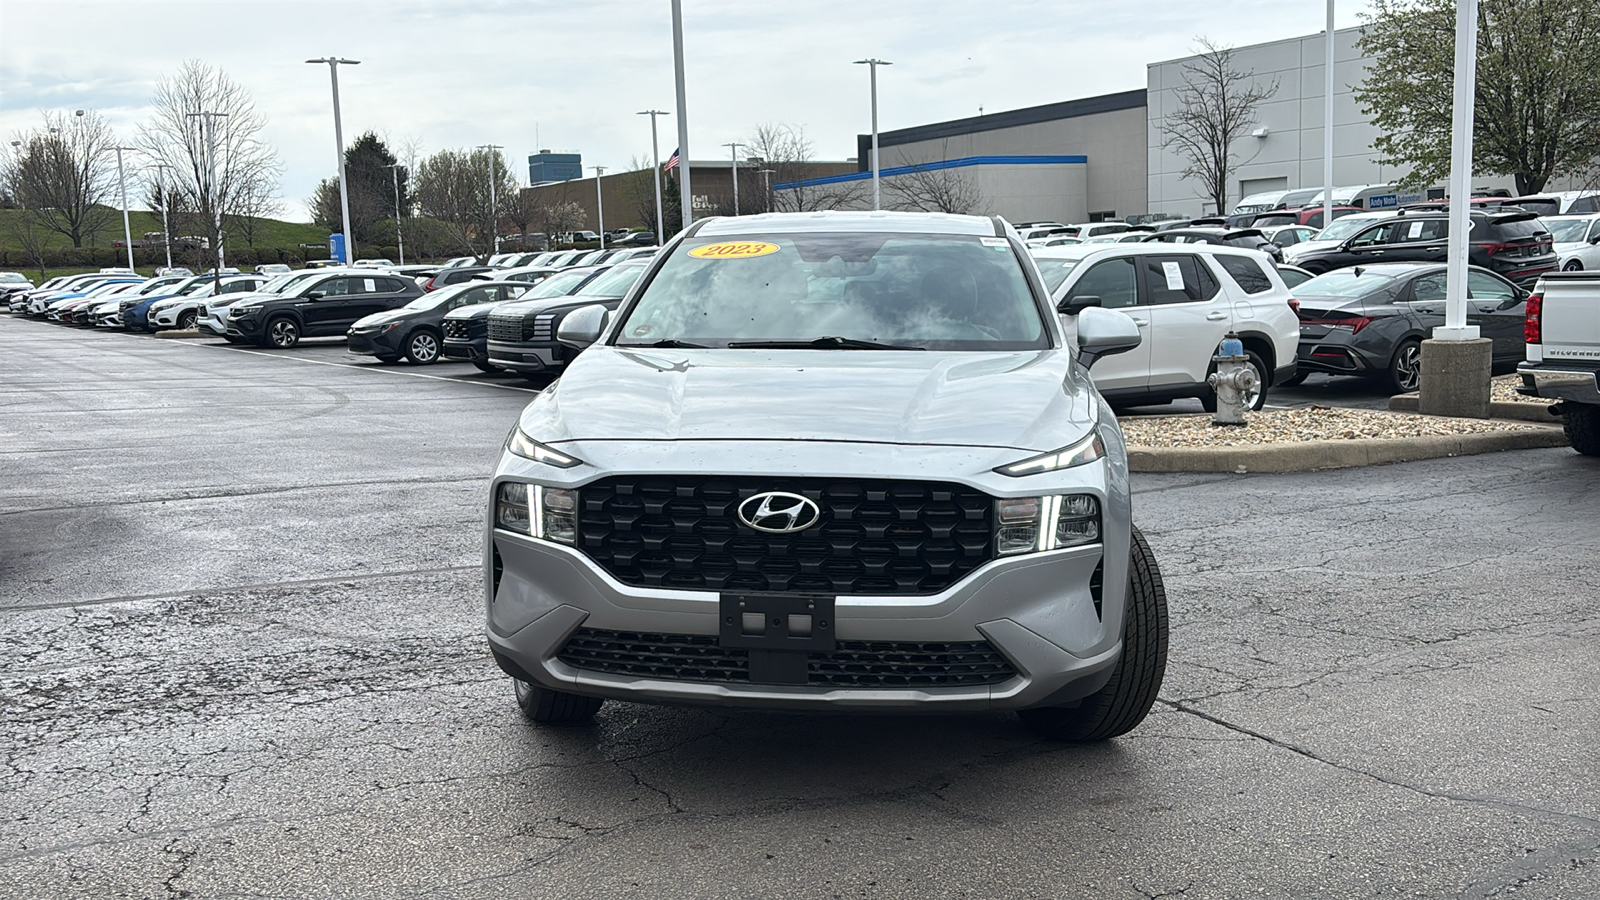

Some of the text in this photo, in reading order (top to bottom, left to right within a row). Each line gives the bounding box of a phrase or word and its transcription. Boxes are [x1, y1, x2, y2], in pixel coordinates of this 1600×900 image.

[1370, 197, 1383, 207] Andy
[1383, 196, 1396, 206] Mohr
[701, 244, 767, 257] 2023
